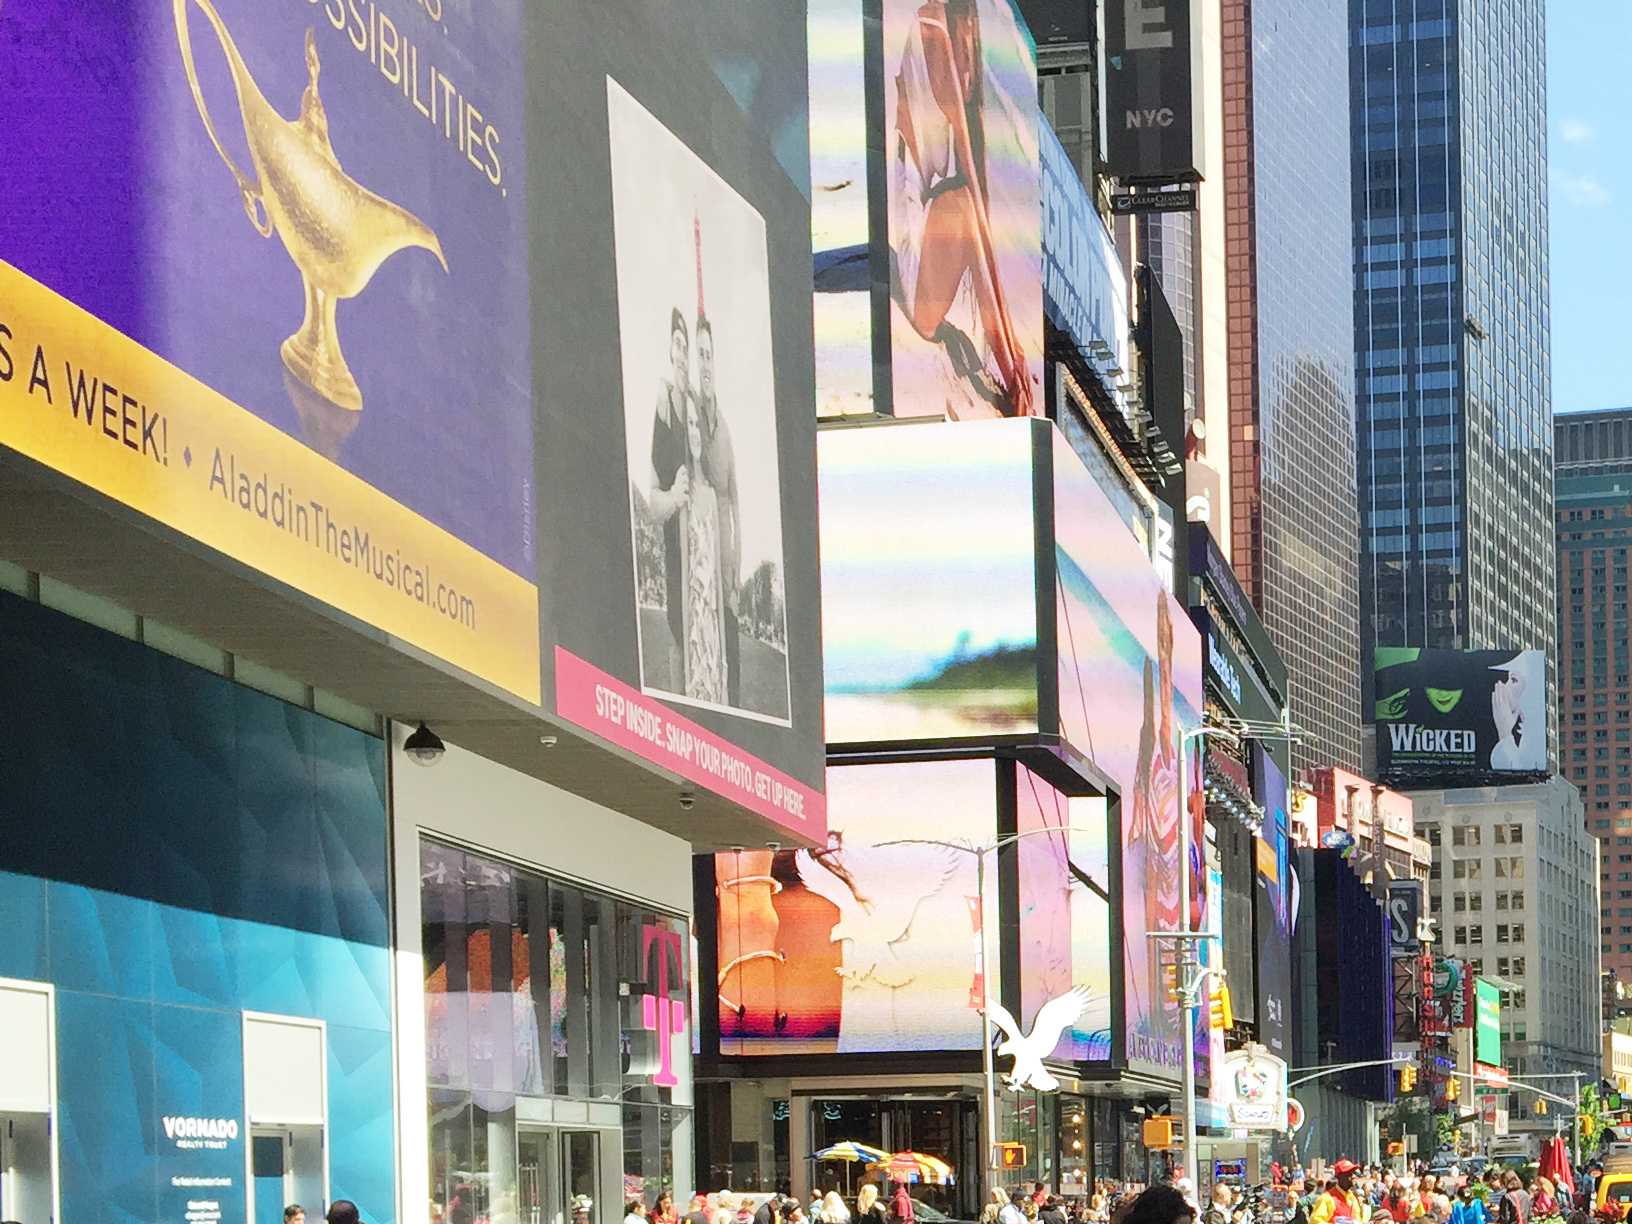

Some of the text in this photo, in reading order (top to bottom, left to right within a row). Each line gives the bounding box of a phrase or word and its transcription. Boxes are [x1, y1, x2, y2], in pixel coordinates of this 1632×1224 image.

[1126, 107, 1174, 129] NYC
[28, 345, 53, 404] A
[65, 361, 169, 467] WEEK!
[209, 447, 477, 629] AladdinTheMusical.com
[595, 684, 807, 820] STEP INSIDE. SNAP YOUR PHOTO. GET UP HERE.
[163, 1116, 238, 1139] VORNADO
